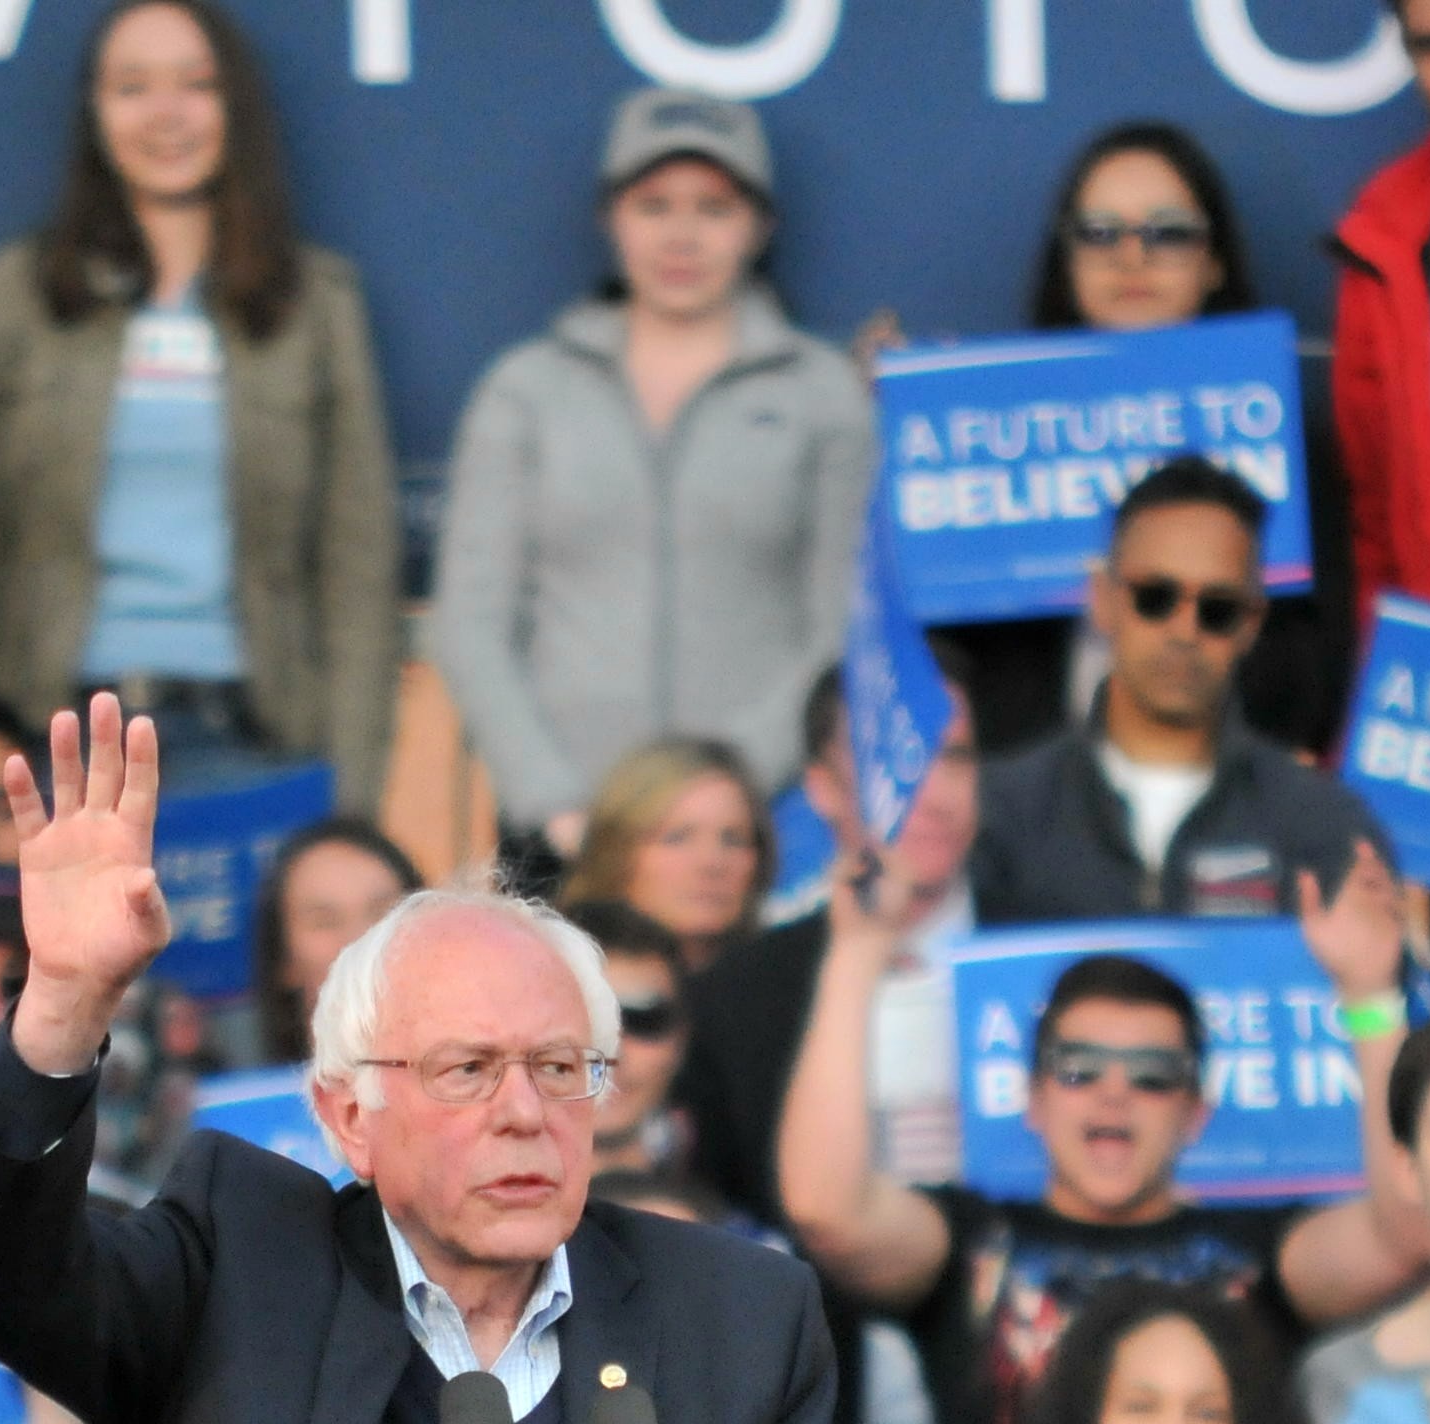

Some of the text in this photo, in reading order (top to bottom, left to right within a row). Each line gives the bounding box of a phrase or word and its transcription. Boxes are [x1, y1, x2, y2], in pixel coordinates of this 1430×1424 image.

[900, 382, 1285, 463] A FUTURE TO
[898, 450, 1159, 531] BELIEV
[1377, 664, 1416, 718] A
[977, 1000, 1023, 1053] A
